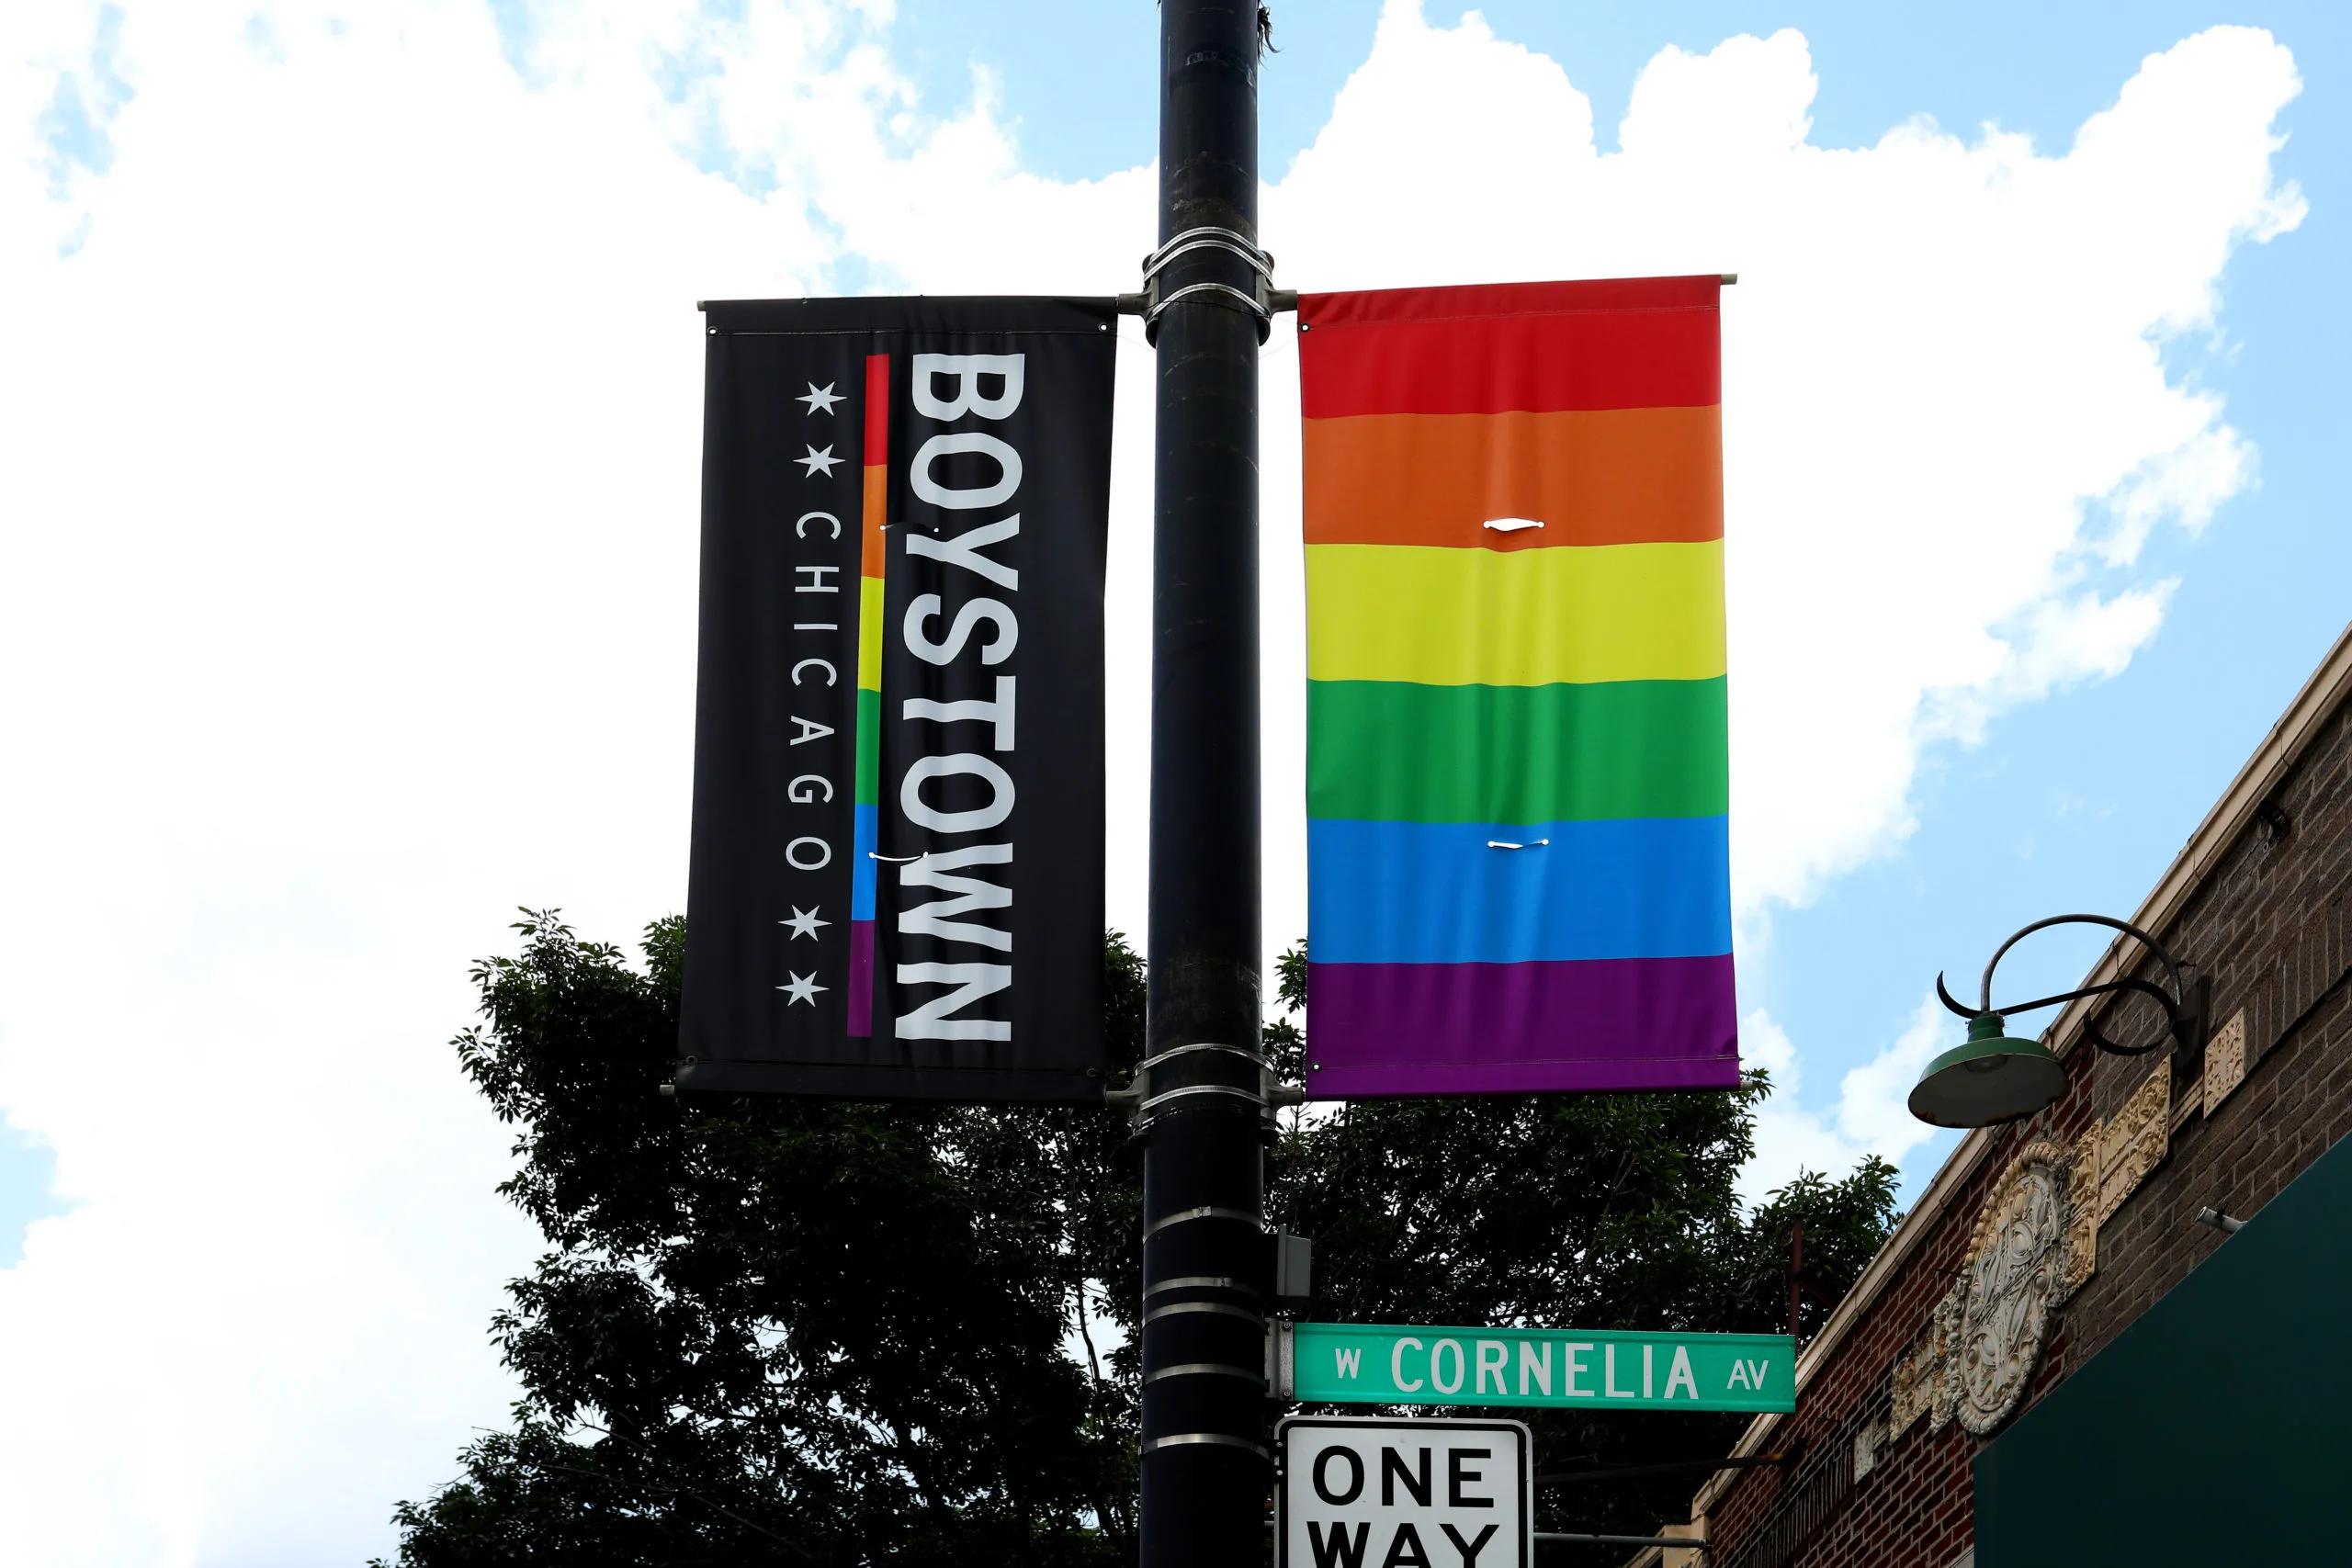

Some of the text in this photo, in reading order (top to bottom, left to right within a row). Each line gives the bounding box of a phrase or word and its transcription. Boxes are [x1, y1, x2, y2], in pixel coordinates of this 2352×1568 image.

[786, 512, 841, 870] CHICAGO
[895, 354, 1024, 1041] BOYSTOWN
[1335, 1337, 1769, 1399] W CORNELIA AV
[1313, 1445, 1494, 1507] ONE
[1306, 1521, 1499, 1568] WAY
